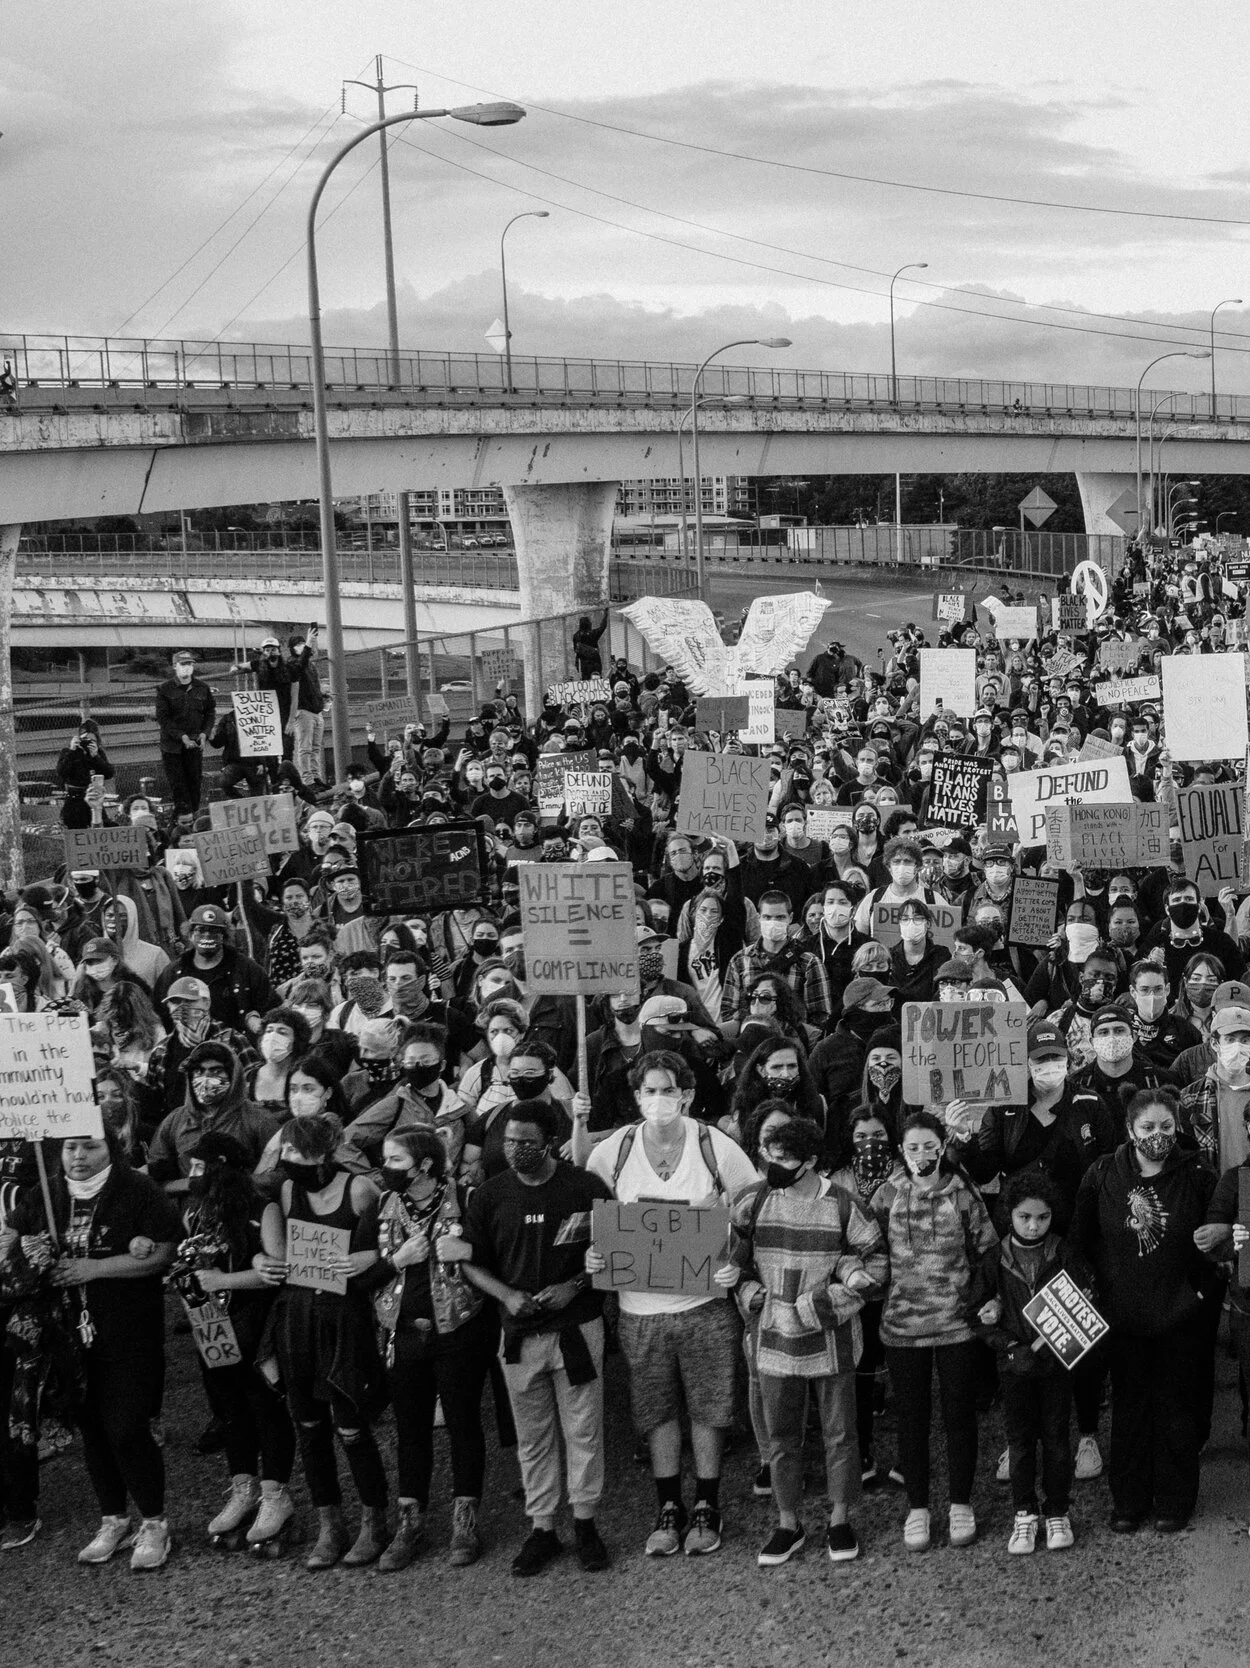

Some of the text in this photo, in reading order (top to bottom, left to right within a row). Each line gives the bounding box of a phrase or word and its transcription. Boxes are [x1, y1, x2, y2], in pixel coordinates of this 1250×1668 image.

[1060, 595, 1087, 606] BLACK
[1060, 606, 1080, 618] LIVES
[1060, 618, 1087, 630] MATTER
[235, 692, 273, 704] BLUE
[1108, 685, 1150, 698] NO PEACE
[236, 703, 275, 715] LIVES
[238, 715, 270, 727] DONUT
[242, 725, 276, 736] MATTER
[574, 752, 590, 764] US
[943, 757, 962, 766] PRIDE
[705, 756, 763, 790] BLACK
[934, 761, 949, 769] AND
[963, 766, 992, 775] PROTEST
[566, 773, 612, 788] DEFUND
[934, 768, 981, 789] BLACK
[1034, 767, 1109, 802] DEFUND
[933, 780, 978, 801] TRANS
[569, 800, 610, 816] POLICE
[702, 792, 757, 813] LIVES
[933, 793, 975, 813] LIVES
[1064, 796, 1083, 806] the
[223, 799, 278, 826] FUCK
[687, 811, 756, 832] MATTER
[927, 804, 979, 827] MATTER
[75, 829, 139, 847] ENOUGH
[202, 828, 251, 846] WHITE
[1081, 831, 1125, 846] BLACK
[77, 850, 140, 867] ENOUGH
[203, 838, 260, 864] SILENCE
[1082, 846, 1126, 858] LIVES
[212, 860, 269, 880] VIOLENCE
[524, 873, 629, 901] WHITE
[1014, 897, 1041, 905] BETTER
[528, 904, 625, 924] SILENCE
[1018, 914, 1050, 923] GETTING
[1011, 926, 1035, 935] BETTER
[532, 959, 636, 981] COMPLIANCE
[5, 1015, 81, 1034] The PPB
[906, 1004, 1023, 1043] POWER to
[11, 1043, 70, 1062] in the
[908, 1041, 1024, 1067] the PEOPLE
[929, 1068, 1013, 1102] BLM
[47, 1110, 72, 1124] the
[525, 1214, 545, 1224] BLM
[617, 1207, 711, 1233] LGBT
[291, 1223, 344, 1249] BLACK
[291, 1245, 339, 1262] LIVES
[652, 1238, 664, 1253] 4
[288, 1264, 344, 1284] MATTER
[610, 1251, 713, 1291] BLM
[1043, 1290, 1088, 1346] BLACK LIVES MATTER
